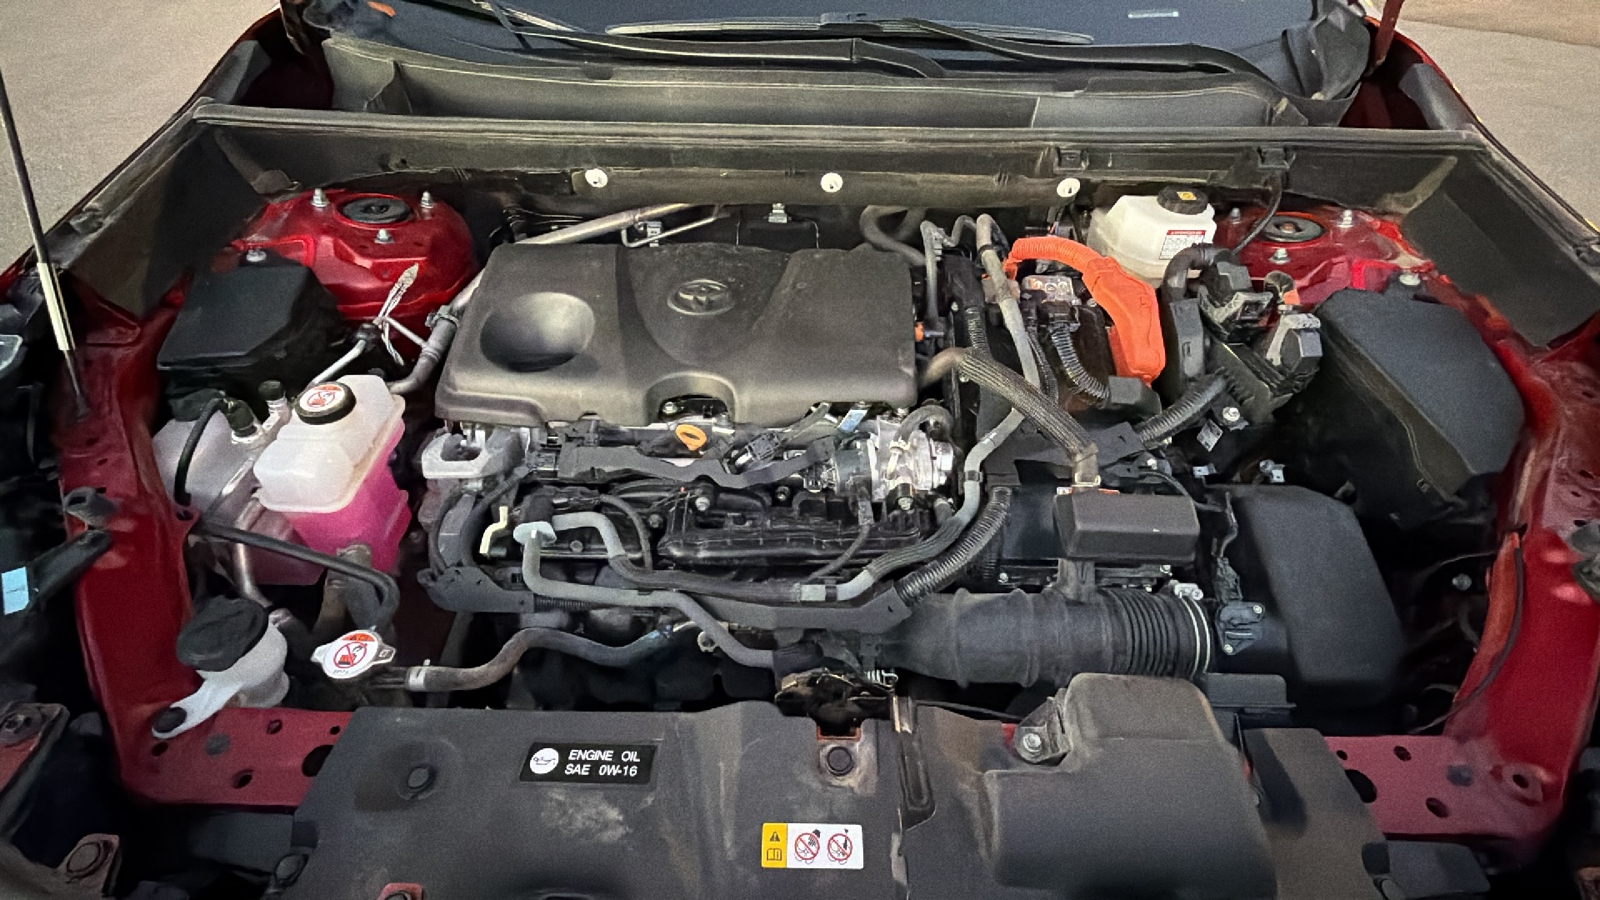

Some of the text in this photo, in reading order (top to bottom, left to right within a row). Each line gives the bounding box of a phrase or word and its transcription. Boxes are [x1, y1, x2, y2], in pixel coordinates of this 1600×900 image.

[568, 749, 641, 762] ENGINE OIL
[564, 763, 638, 777] SAE 0W-16
